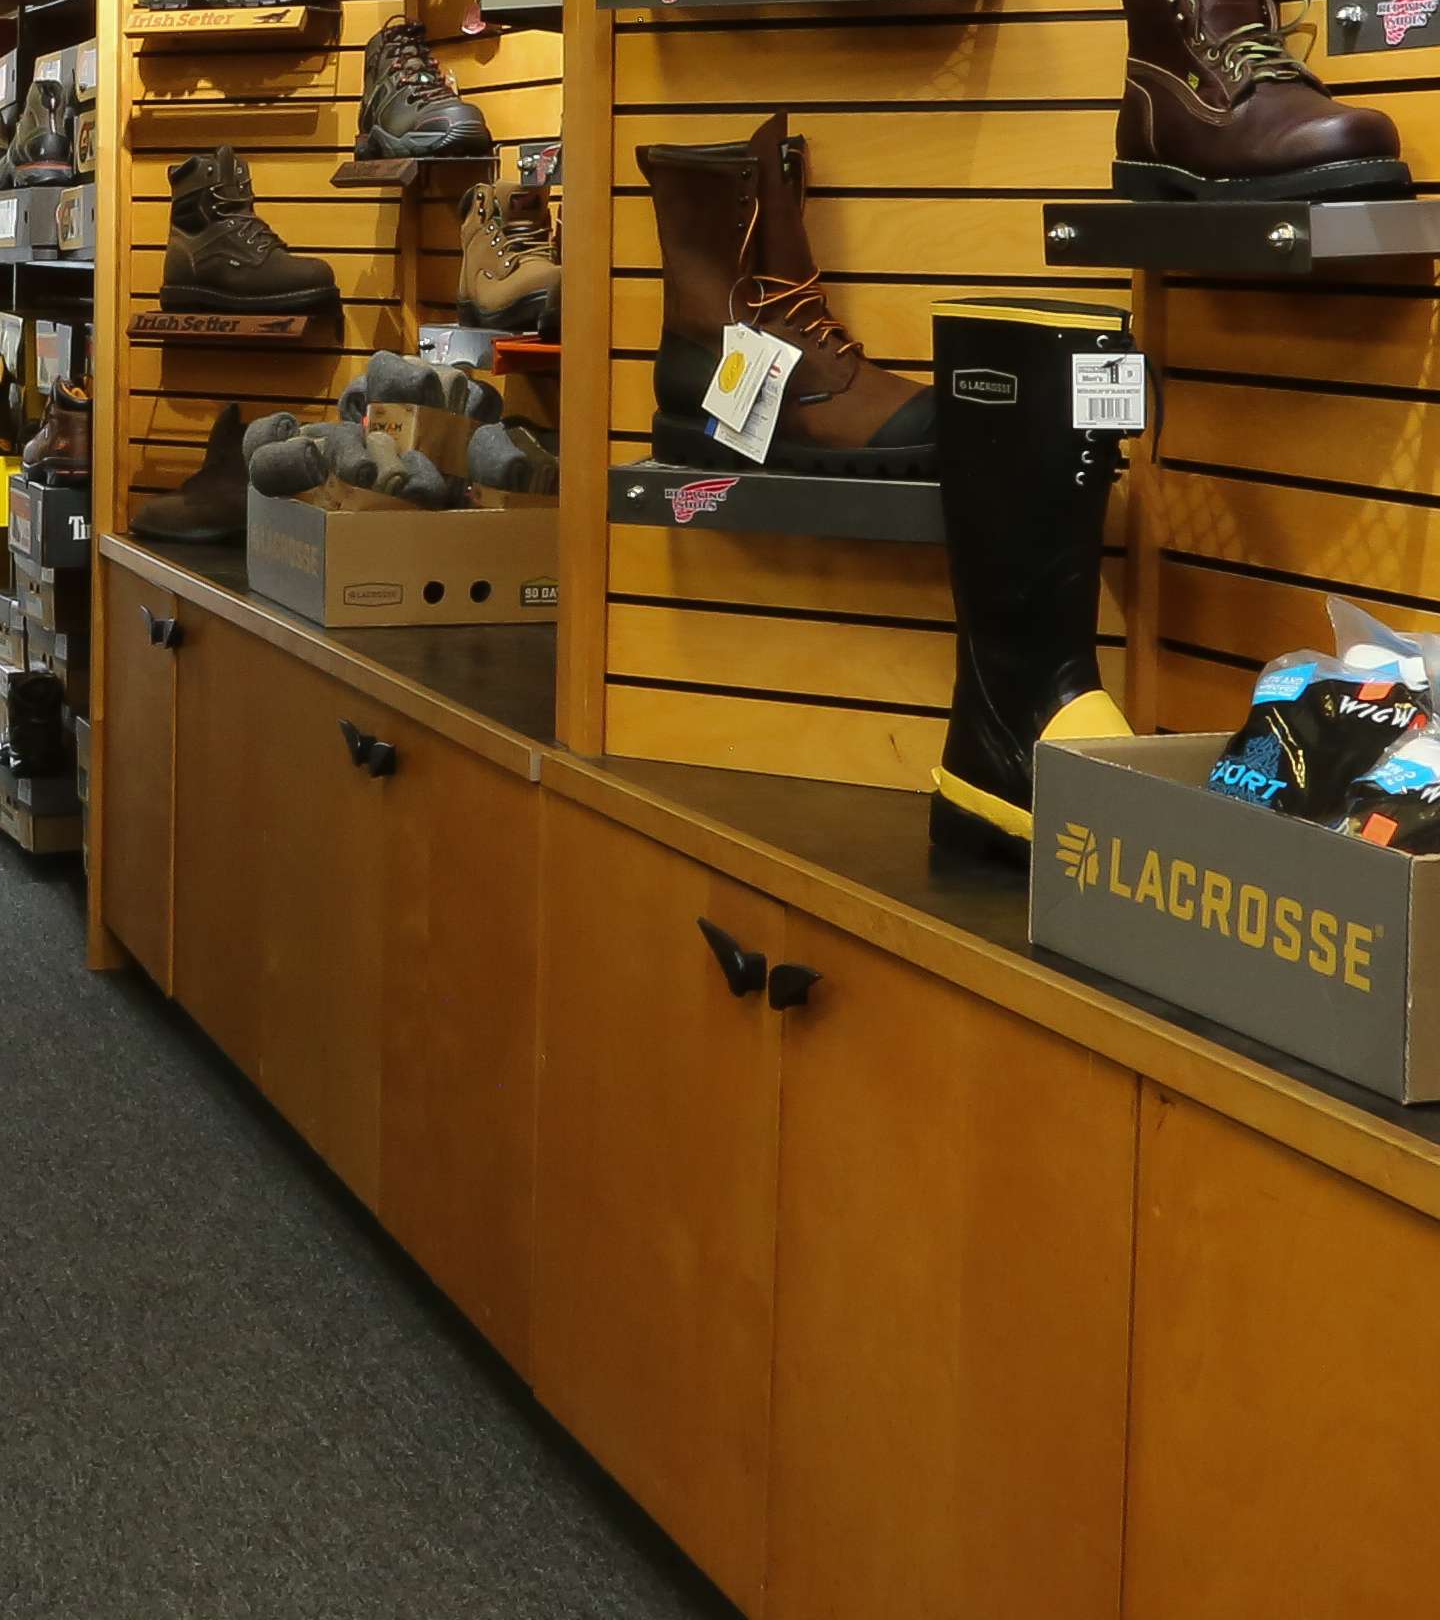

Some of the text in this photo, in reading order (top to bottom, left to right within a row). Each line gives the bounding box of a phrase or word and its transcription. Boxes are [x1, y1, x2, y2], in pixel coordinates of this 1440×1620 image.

[1402, 0, 1438, 13] WING
[130, 13, 235, 28] Irish Setter
[134, 315, 240, 332] Irish Setter
[969, 380, 1011, 393] LACROSSE
[1339, 695, 1428, 730] WIGWA
[1109, 839, 1373, 992] LACROSSE
